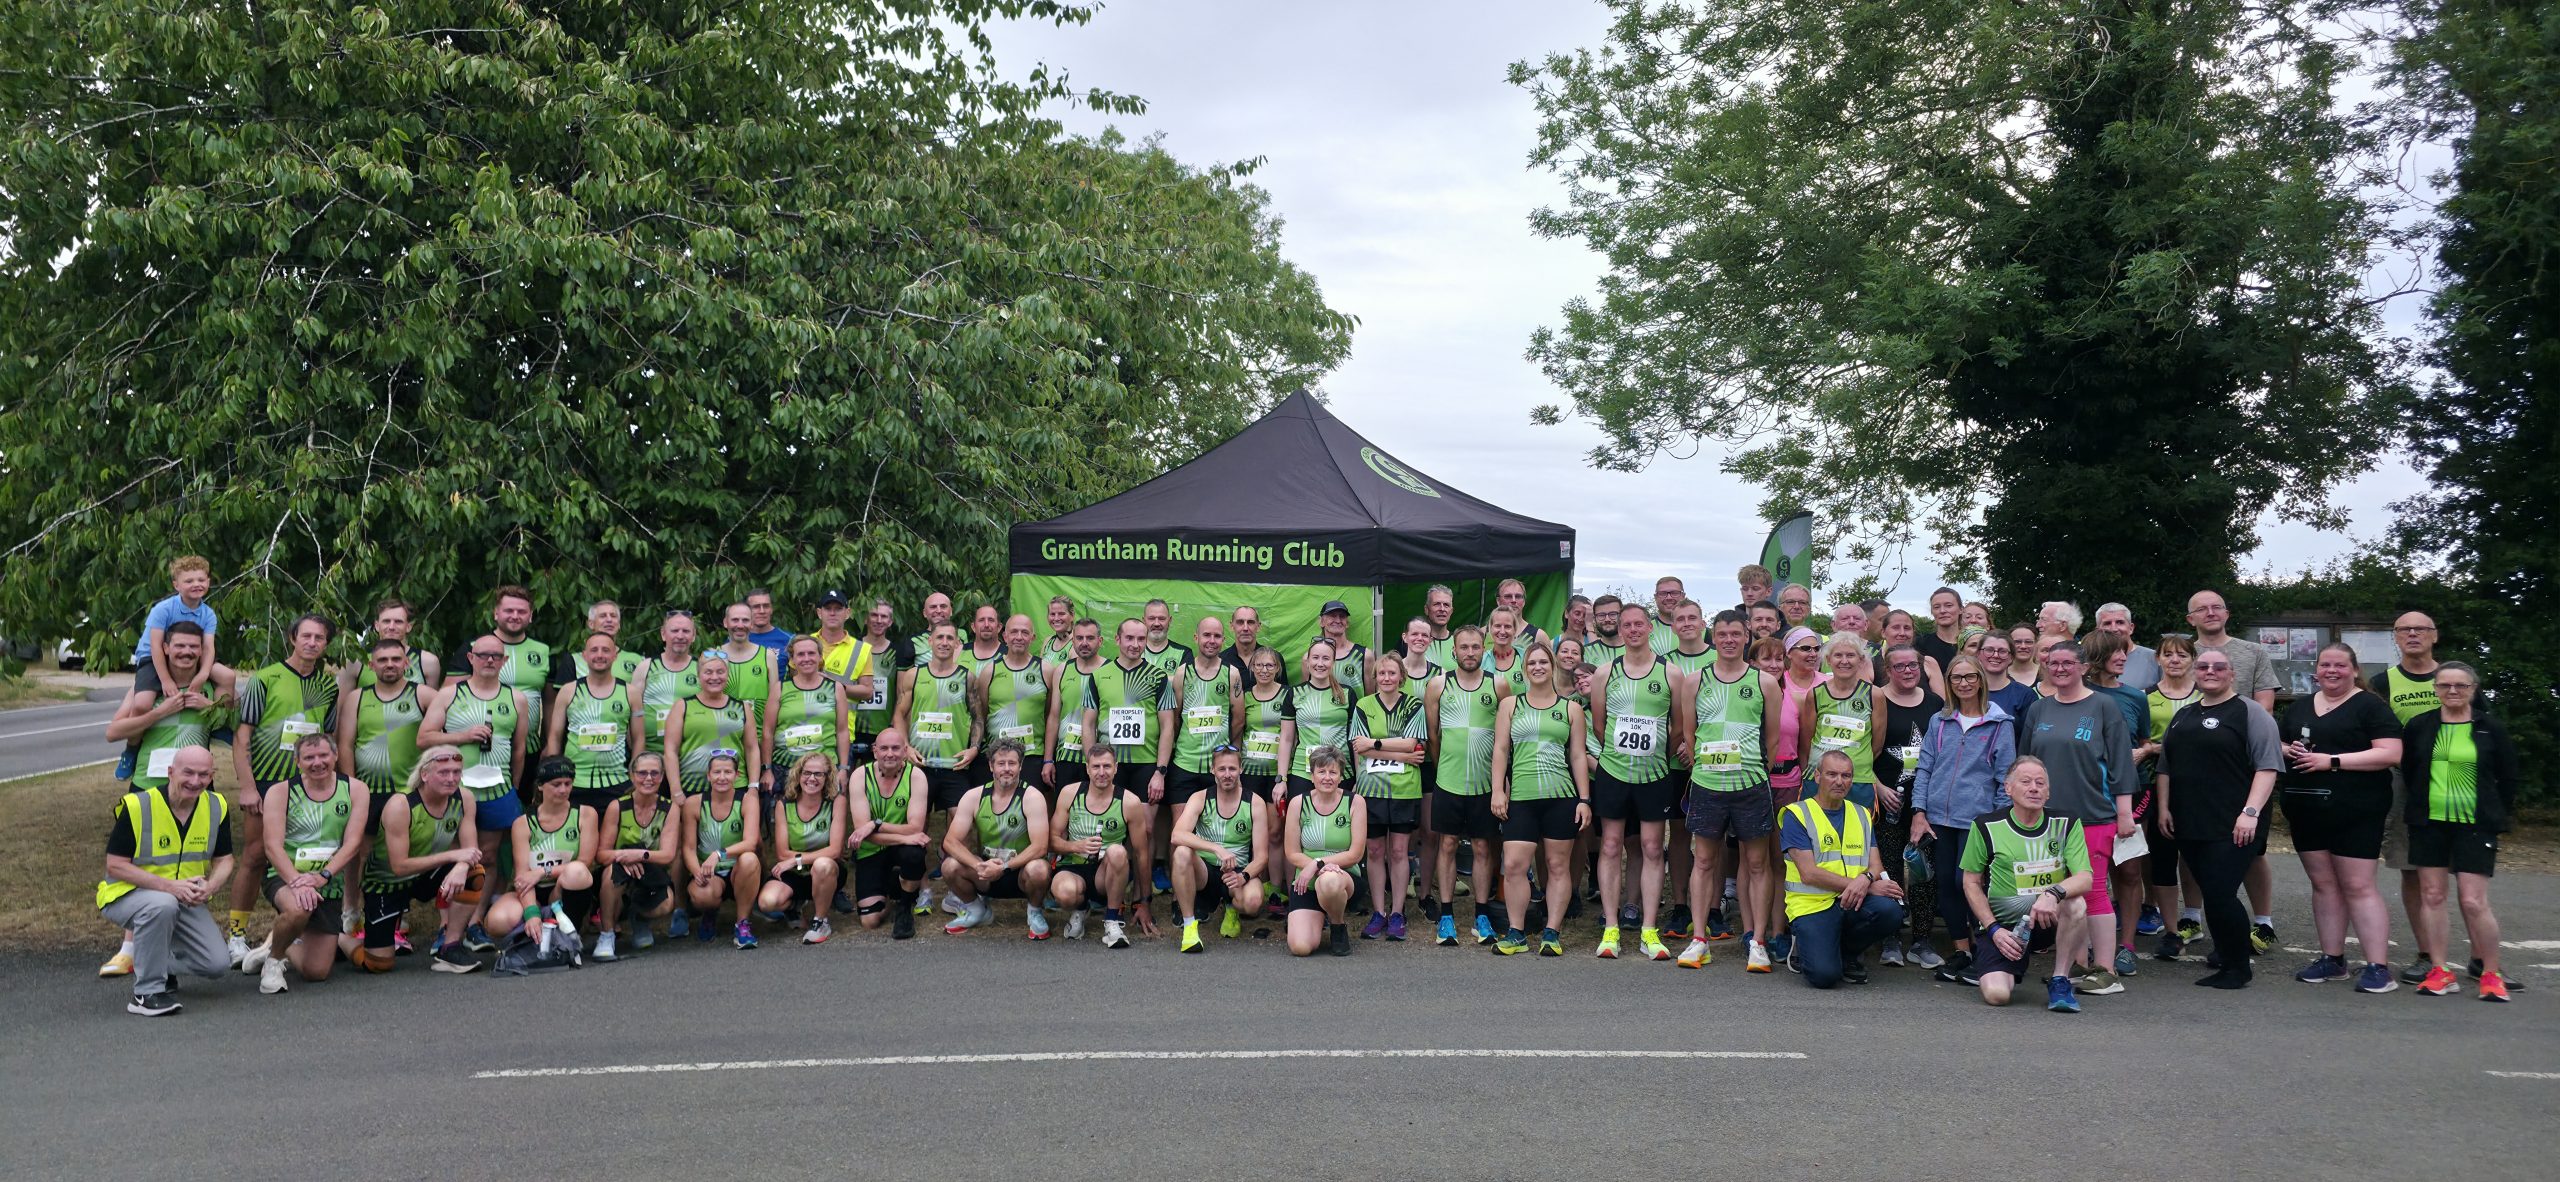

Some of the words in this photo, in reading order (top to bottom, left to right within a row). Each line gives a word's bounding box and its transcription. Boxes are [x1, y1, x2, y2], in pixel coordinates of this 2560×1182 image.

[1041, 537, 1158, 560] Grantham
[1167, 538, 1273, 570] Running
[1283, 541, 1345, 568] Club
[2393, 691, 2438, 703] GRANTH
[1199, 717, 1214, 726] 759
[1630, 717, 1654, 725] ROPSLEY
[927, 723, 942, 732] 754
[1113, 723, 1141, 738] 288
[1833, 727, 1852, 739] 763
[591, 735, 607, 744] 769
[1073, 735, 1082, 744] 76
[2075, 728, 2092, 741] 20
[796, 736, 812, 745] 795
[1619, 731, 1651, 751] 298
[1257, 742, 1271, 752] 777
[1711, 753, 1728, 764] 767
[2031, 873, 2052, 887] 768
